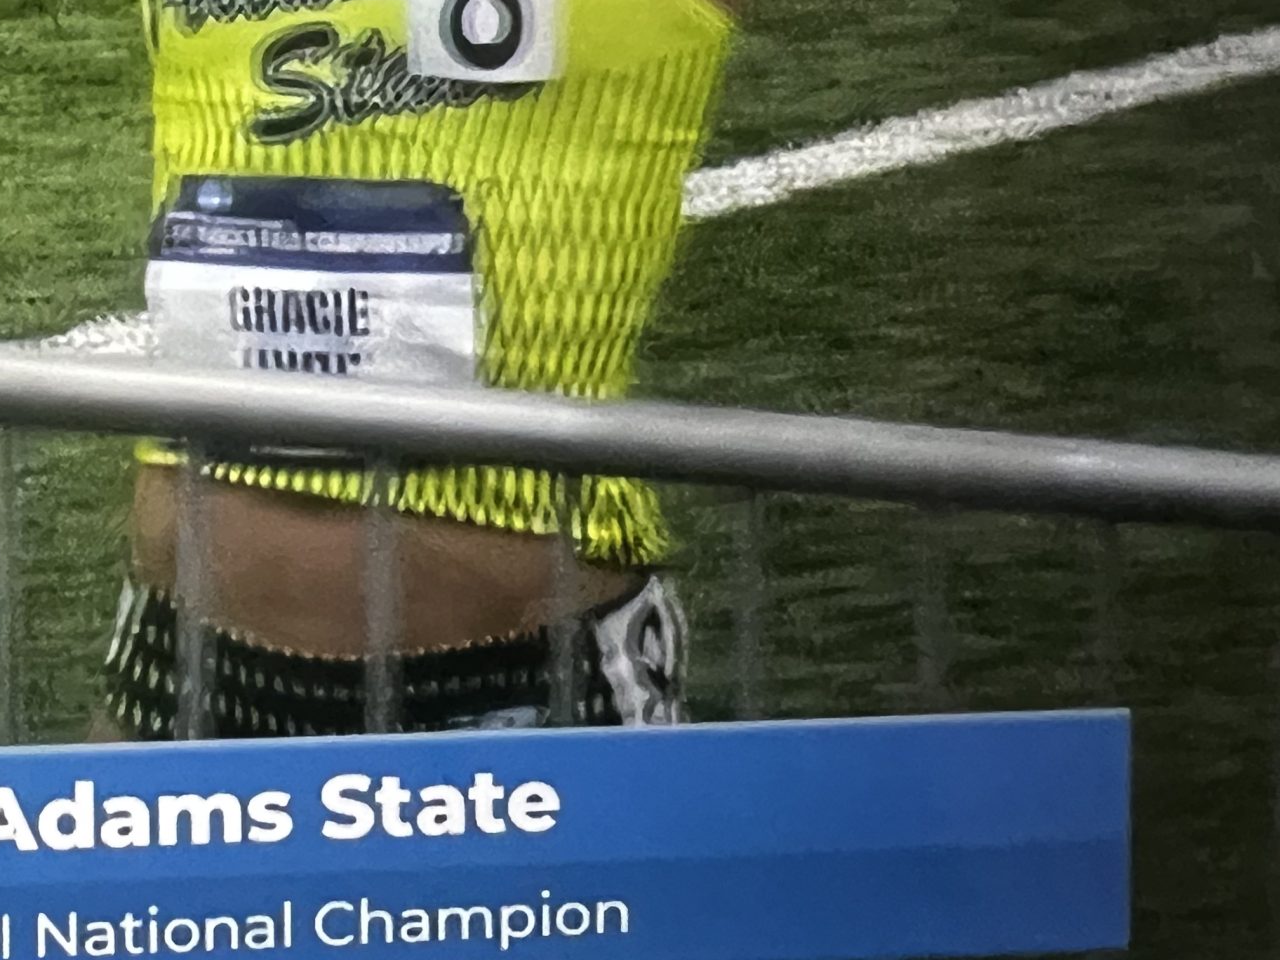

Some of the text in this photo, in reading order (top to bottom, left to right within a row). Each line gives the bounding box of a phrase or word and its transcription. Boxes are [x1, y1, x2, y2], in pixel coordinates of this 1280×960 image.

[321, 772, 561, 840] State
[37, 900, 292, 958] National
[314, 889, 630, 951] Champion
